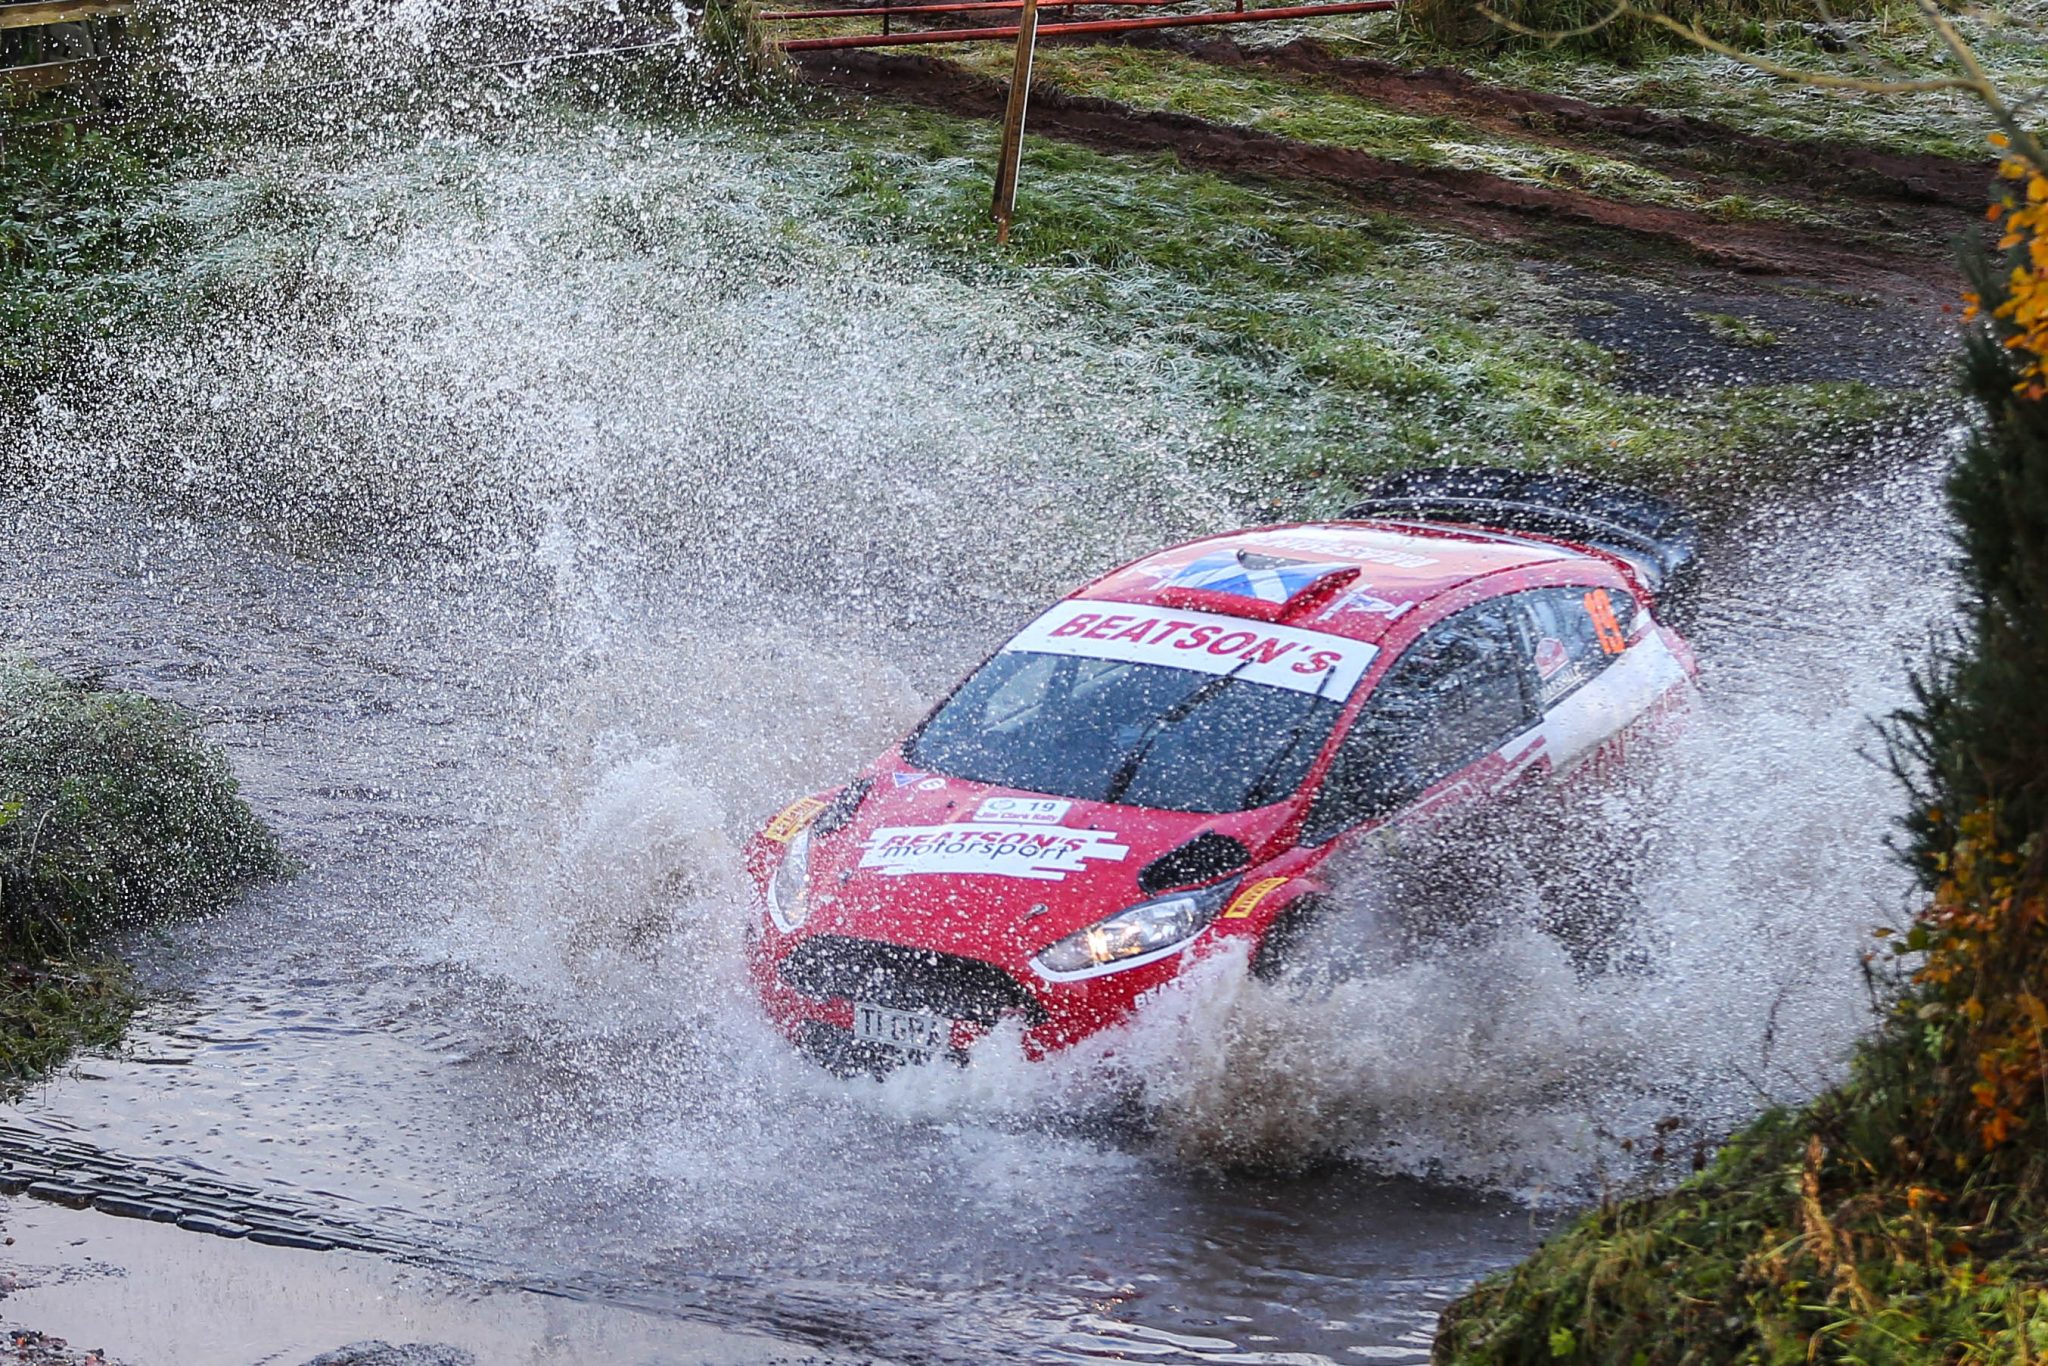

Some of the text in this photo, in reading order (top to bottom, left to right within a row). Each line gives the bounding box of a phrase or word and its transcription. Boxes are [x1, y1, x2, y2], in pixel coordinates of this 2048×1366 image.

[1048, 613, 1342, 675] BEATSON'S
[1030, 802, 1056, 812] 19
[882, 840, 1076, 860] motorsport
